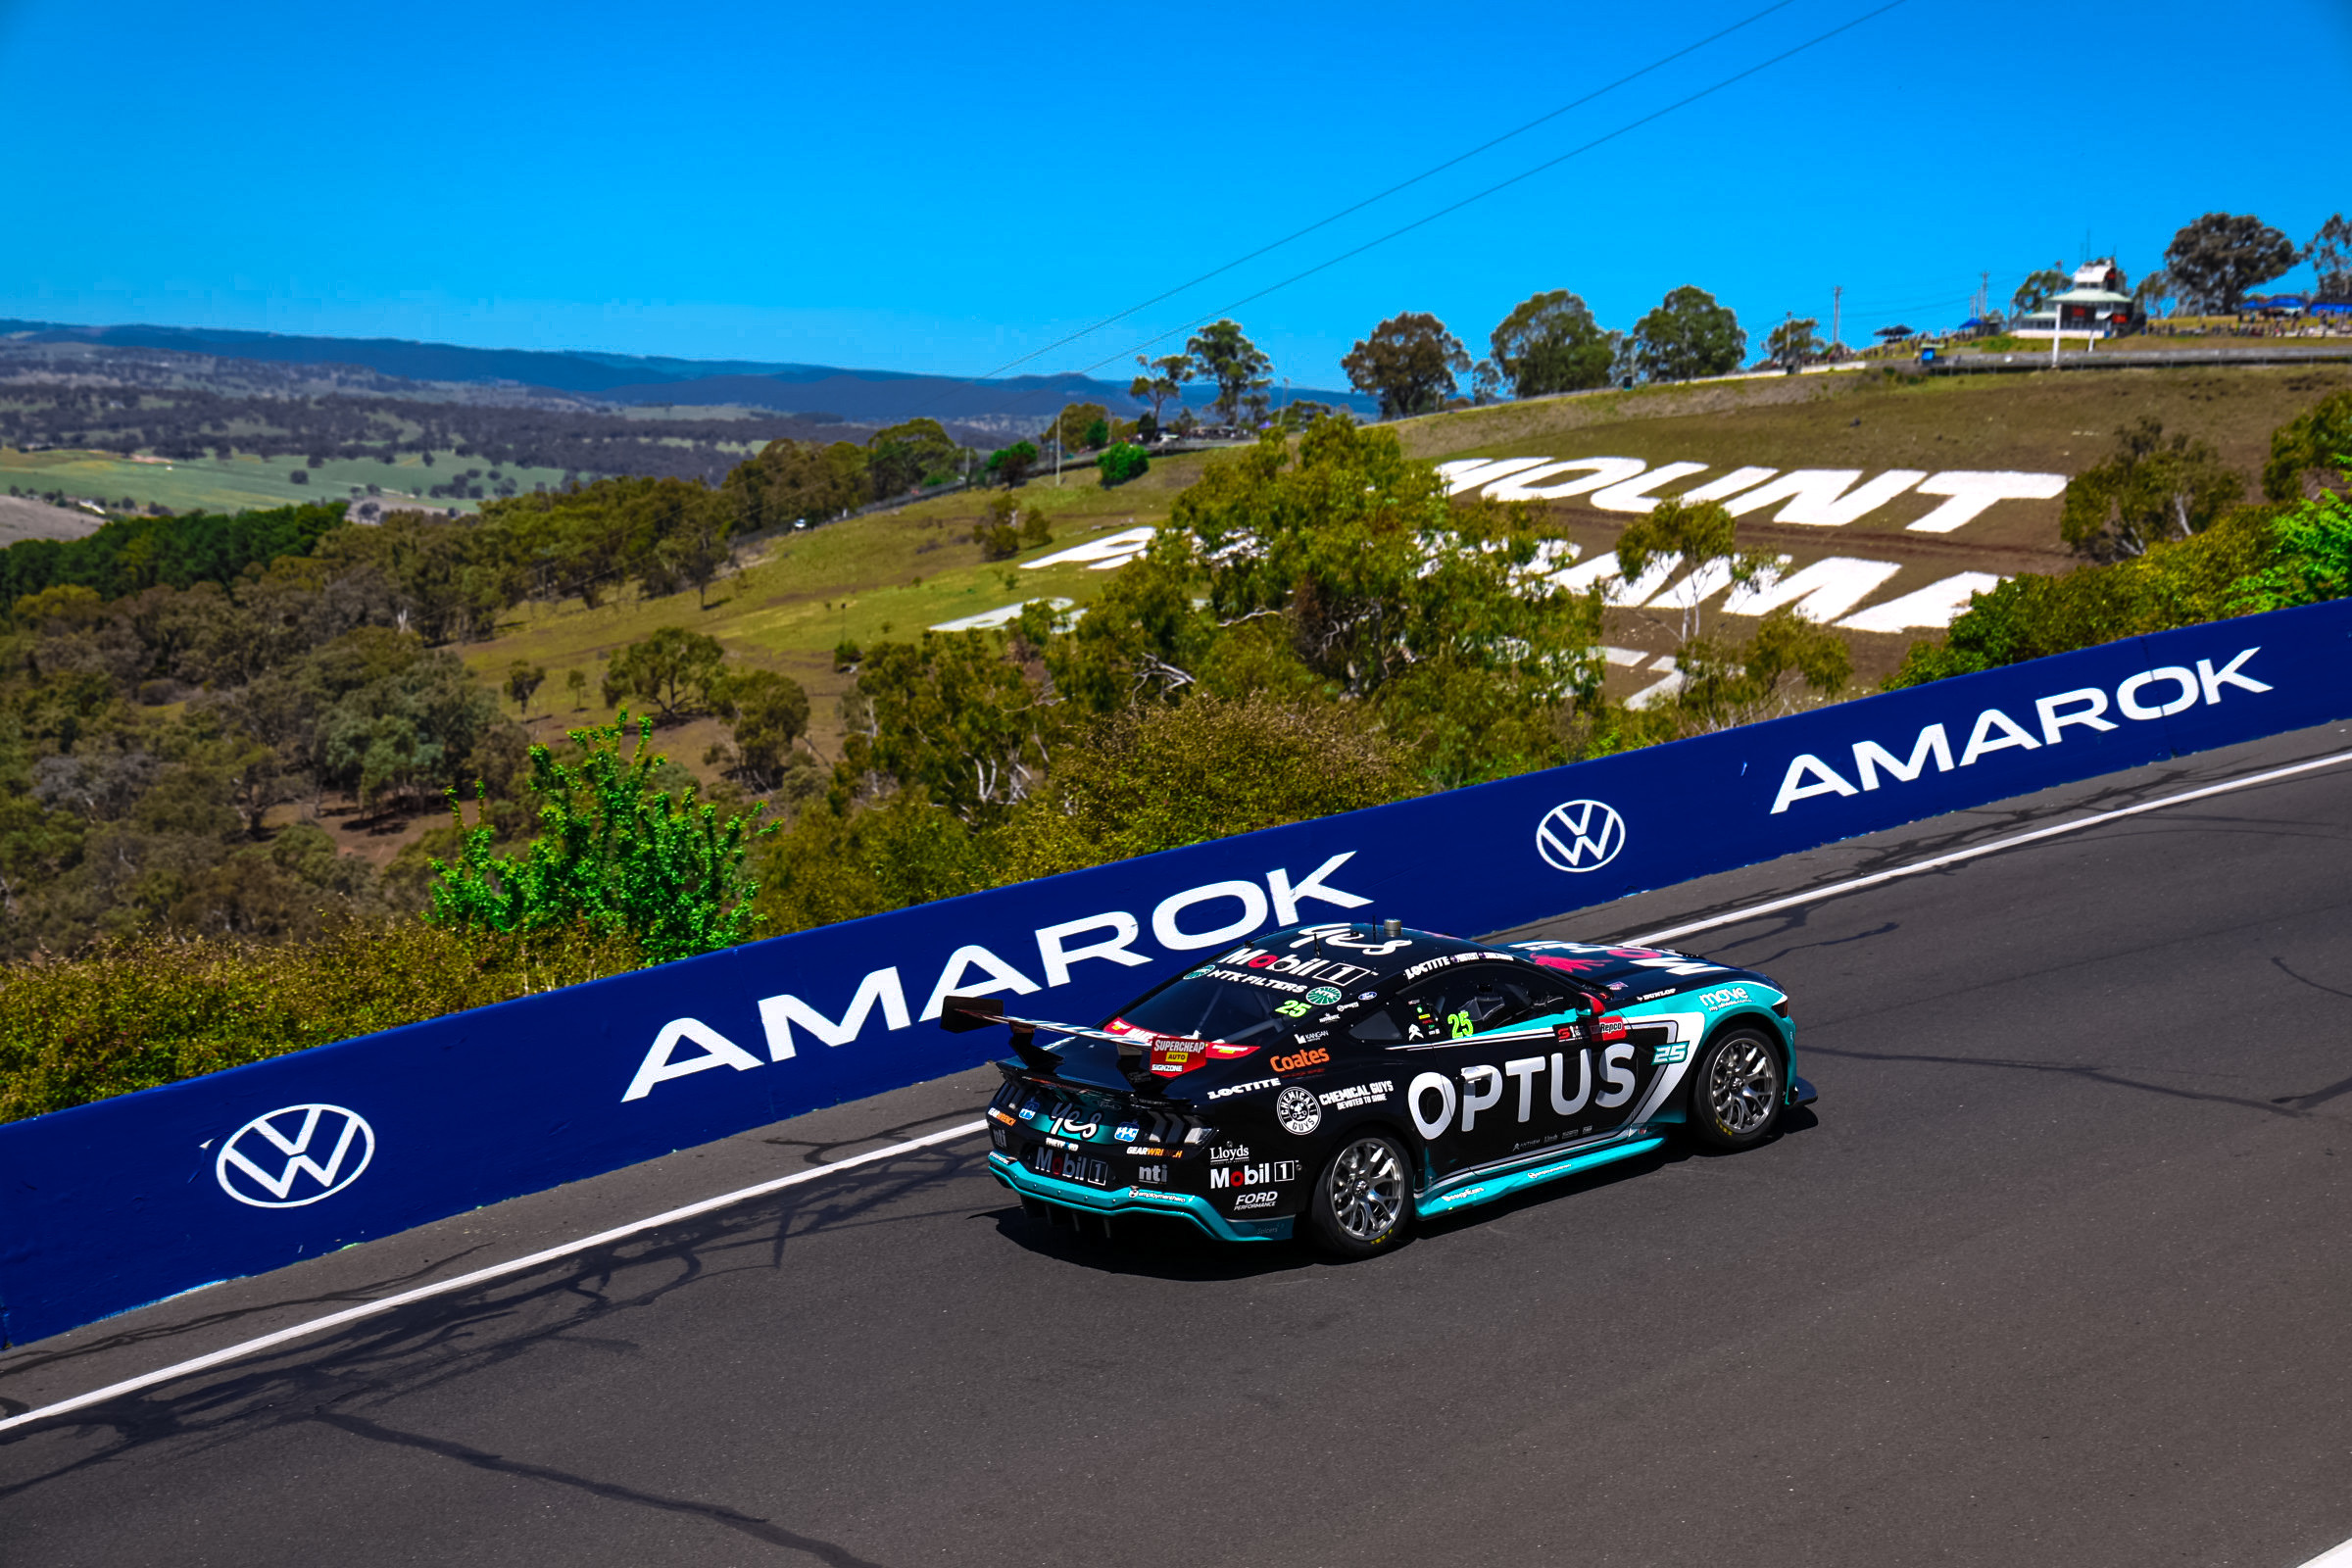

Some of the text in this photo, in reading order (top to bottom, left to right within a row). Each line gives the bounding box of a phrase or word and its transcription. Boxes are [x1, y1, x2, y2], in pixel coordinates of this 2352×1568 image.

[1770, 646, 2274, 814] AMAROK
[1217, 947, 1330, 977] Mobil
[1404, 956, 1451, 980] LOCTITE
[621, 850, 1374, 1103] AMAROK
[1206, 968, 1249, 982] NTK
[1241, 974, 1309, 994] FILTERS
[1642, 987, 1677, 1001] DUNLOP
[1698, 987, 1749, 1006] move
[1275, 999, 1313, 1018] 25
[1304, 1030, 1329, 1040] KANGAN
[1446, 1010, 1475, 1040] 25
[1599, 1021, 1623, 1034] Repco
[1153, 1039, 1205, 1054] SUPERCHEAP
[1653, 1044, 1687, 1064] 25
[1269, 1047, 1331, 1073] Coates
[1206, 1077, 1282, 1101] LOCTITE
[1318, 1080, 1395, 1105] CHEMICAL GUYS
[1407, 1042, 1637, 1141] OPTUS
[1336, 1097, 1364, 1110] DEVOTED
[1364, 1095, 1372, 1103] TO
[1051, 1101, 1103, 1140] yes
[1292, 1117, 1315, 1132] GUYS
[1126, 1146, 1184, 1158] GEARWRH
[1209, 1144, 1250, 1161] Lloyds
[1035, 1147, 1088, 1181] Mobil
[1138, 1164, 1168, 1183] nti
[1210, 1162, 1270, 1189] Mobil
[1233, 1200, 1277, 1211] PERFORMANCE
[1235, 1191, 1278, 1205] FORD
